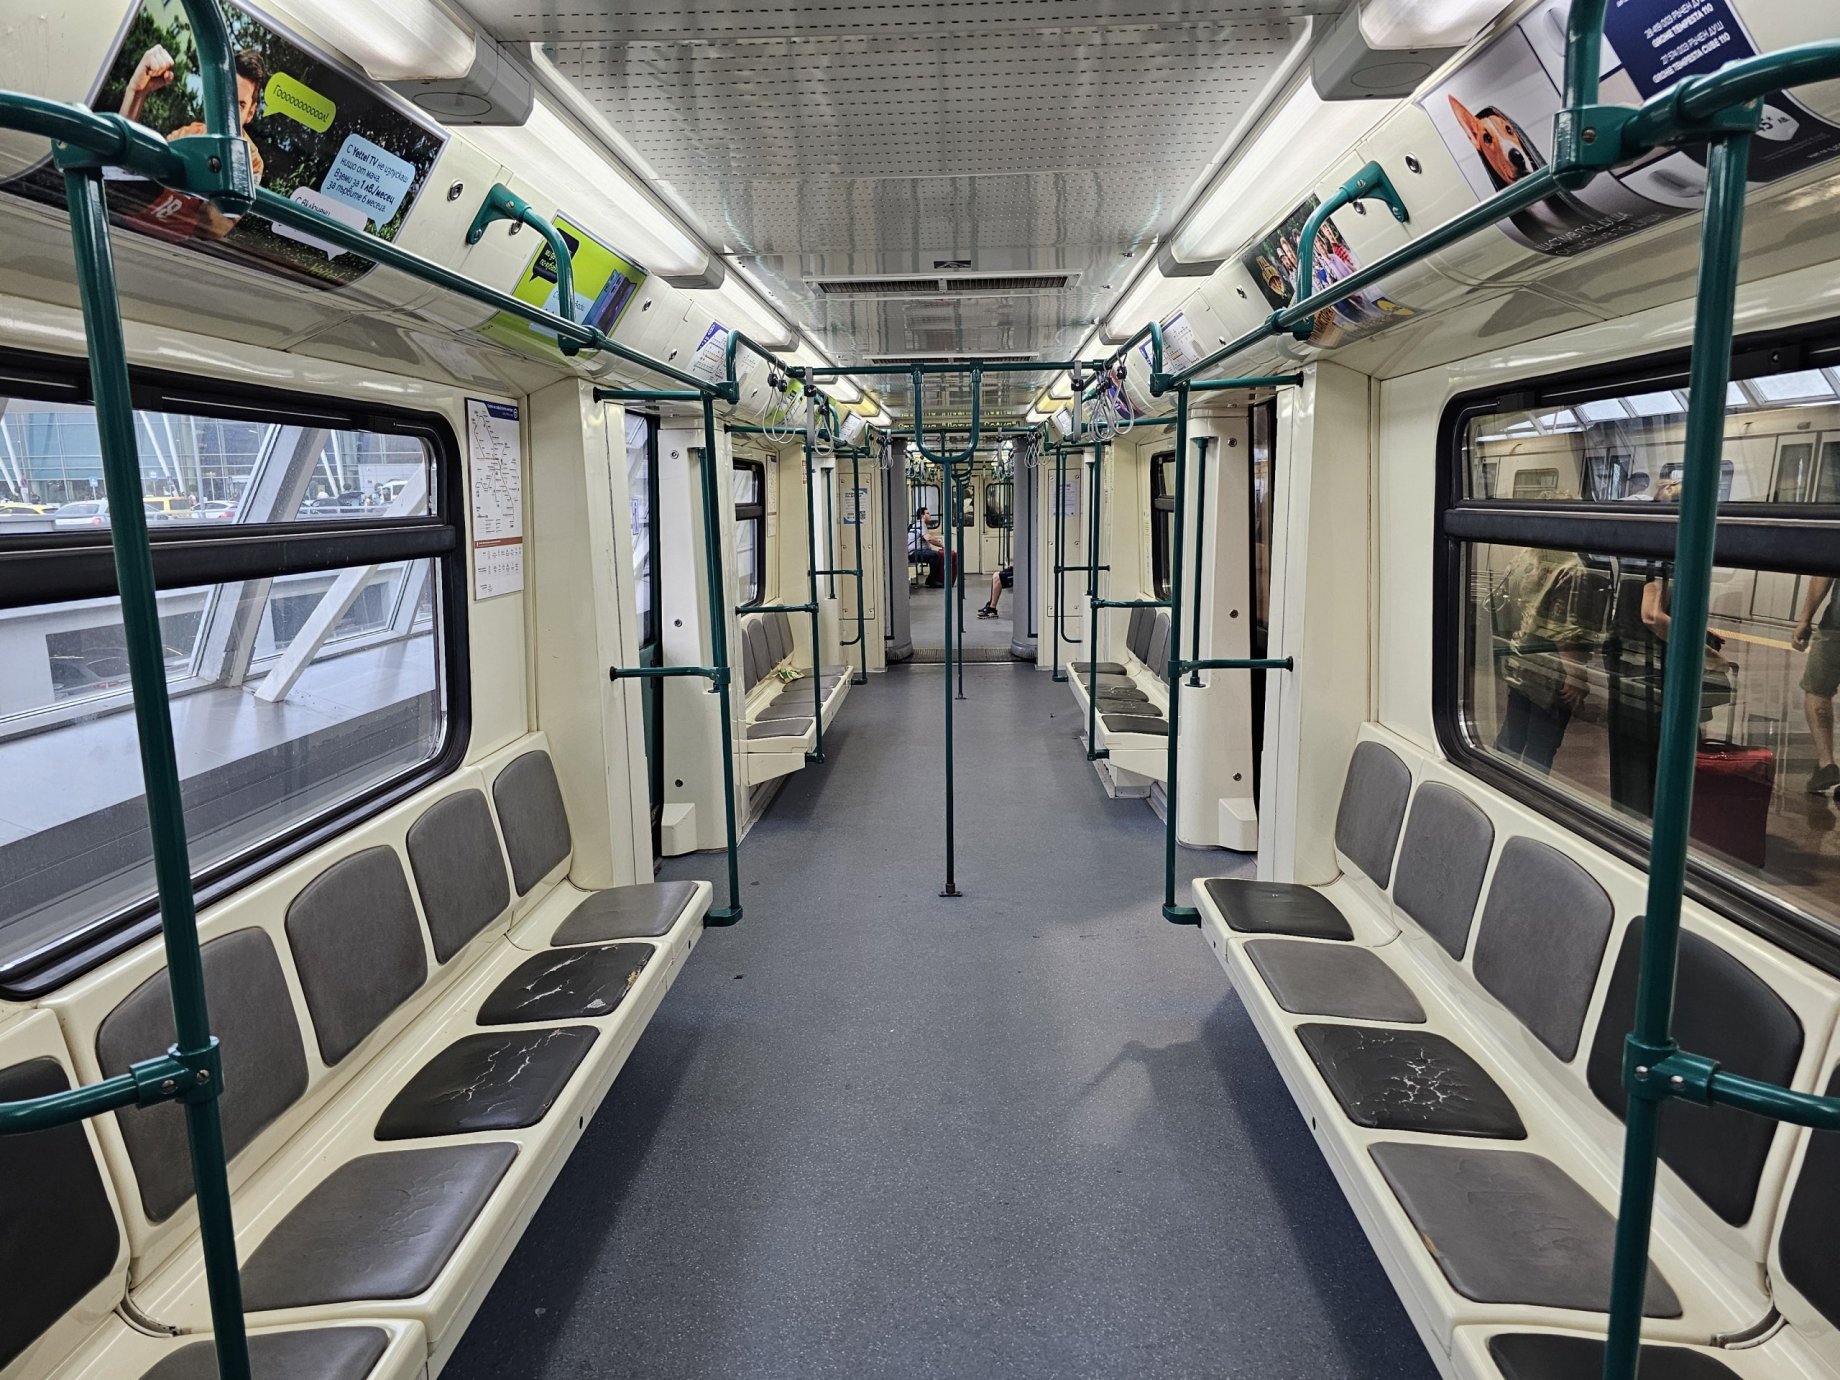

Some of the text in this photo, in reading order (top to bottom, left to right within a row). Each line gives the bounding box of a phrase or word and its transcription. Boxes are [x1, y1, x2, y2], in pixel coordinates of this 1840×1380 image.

[1701, 3, 1714, 18] 110
[1708, 20, 1725, 37] ДУШ
[1701, 37, 1721, 54] CUBE
[1718, 32, 1731, 45] 110
[340, 157, 357, 173] нищо
[356, 165, 367, 176] от
[346, 144, 409, 184] С Yettel TV не изпускаш
[333, 167, 352, 183] Вземи
[351, 178, 360, 189] за
[327, 180, 336, 191] за
[335, 184, 364, 202] първите
